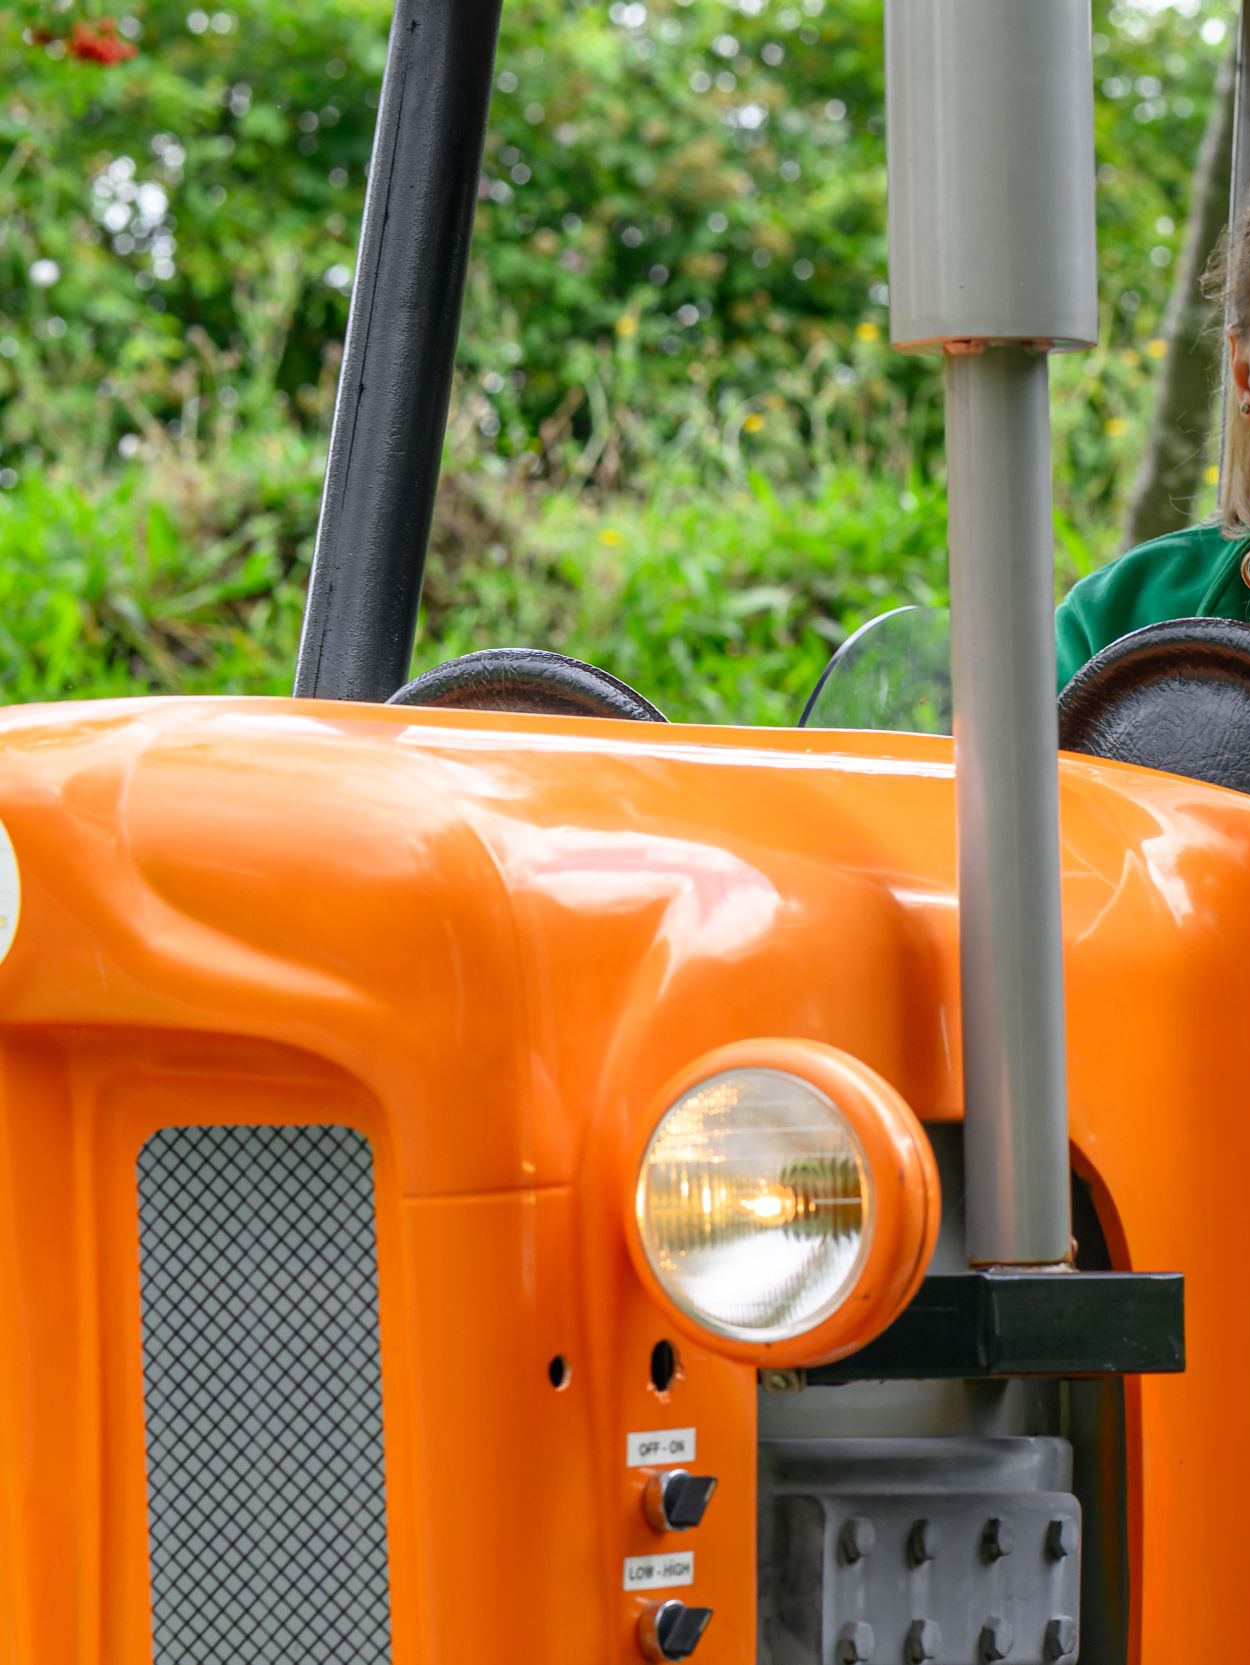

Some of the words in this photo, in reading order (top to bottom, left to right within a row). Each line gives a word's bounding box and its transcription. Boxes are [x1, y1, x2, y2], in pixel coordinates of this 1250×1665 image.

[639, 1441, 660, 1456] OFF
[669, 1440, 685, 1454] ON
[629, 1565, 655, 1580] LOW
[663, 1563, 690, 1578] HIGH
